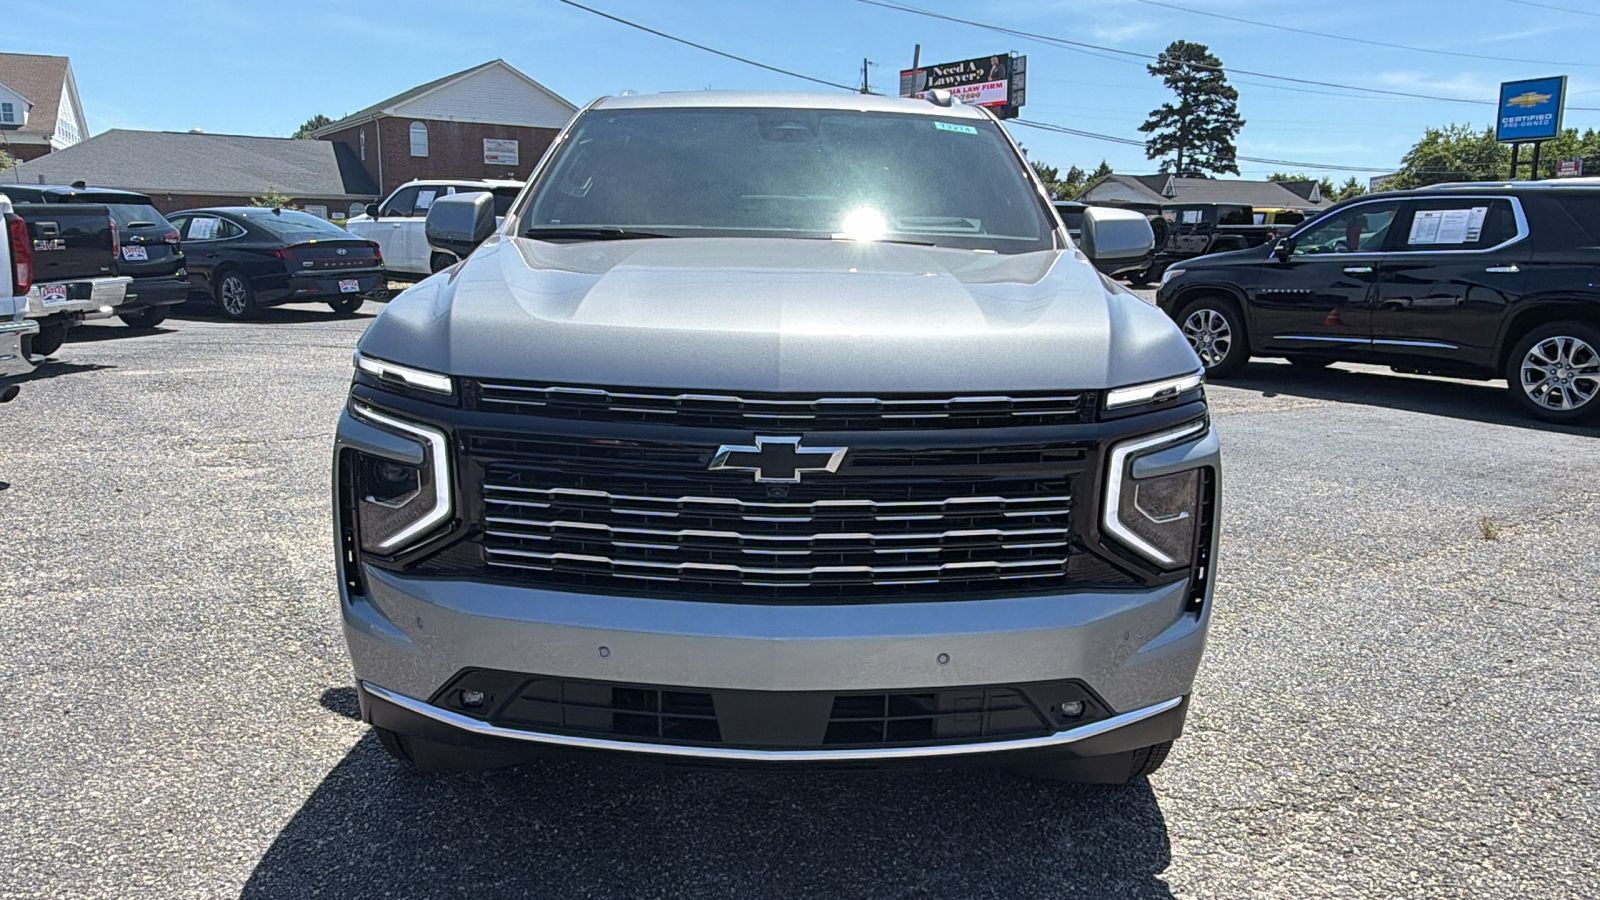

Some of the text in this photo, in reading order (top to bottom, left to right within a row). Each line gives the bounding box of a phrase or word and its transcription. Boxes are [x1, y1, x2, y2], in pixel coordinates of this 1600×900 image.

[933, 62, 964, 76] Need
[966, 61, 977, 71] A
[928, 68, 984, 87] Lawyer?
[963, 85, 980, 93] LAW
[982, 82, 1003, 91] FIRM
[1502, 113, 1553, 123] CERTIFIED
[1503, 119, 1550, 128] PRE-OWNED
[33, 239, 66, 251] GMC
